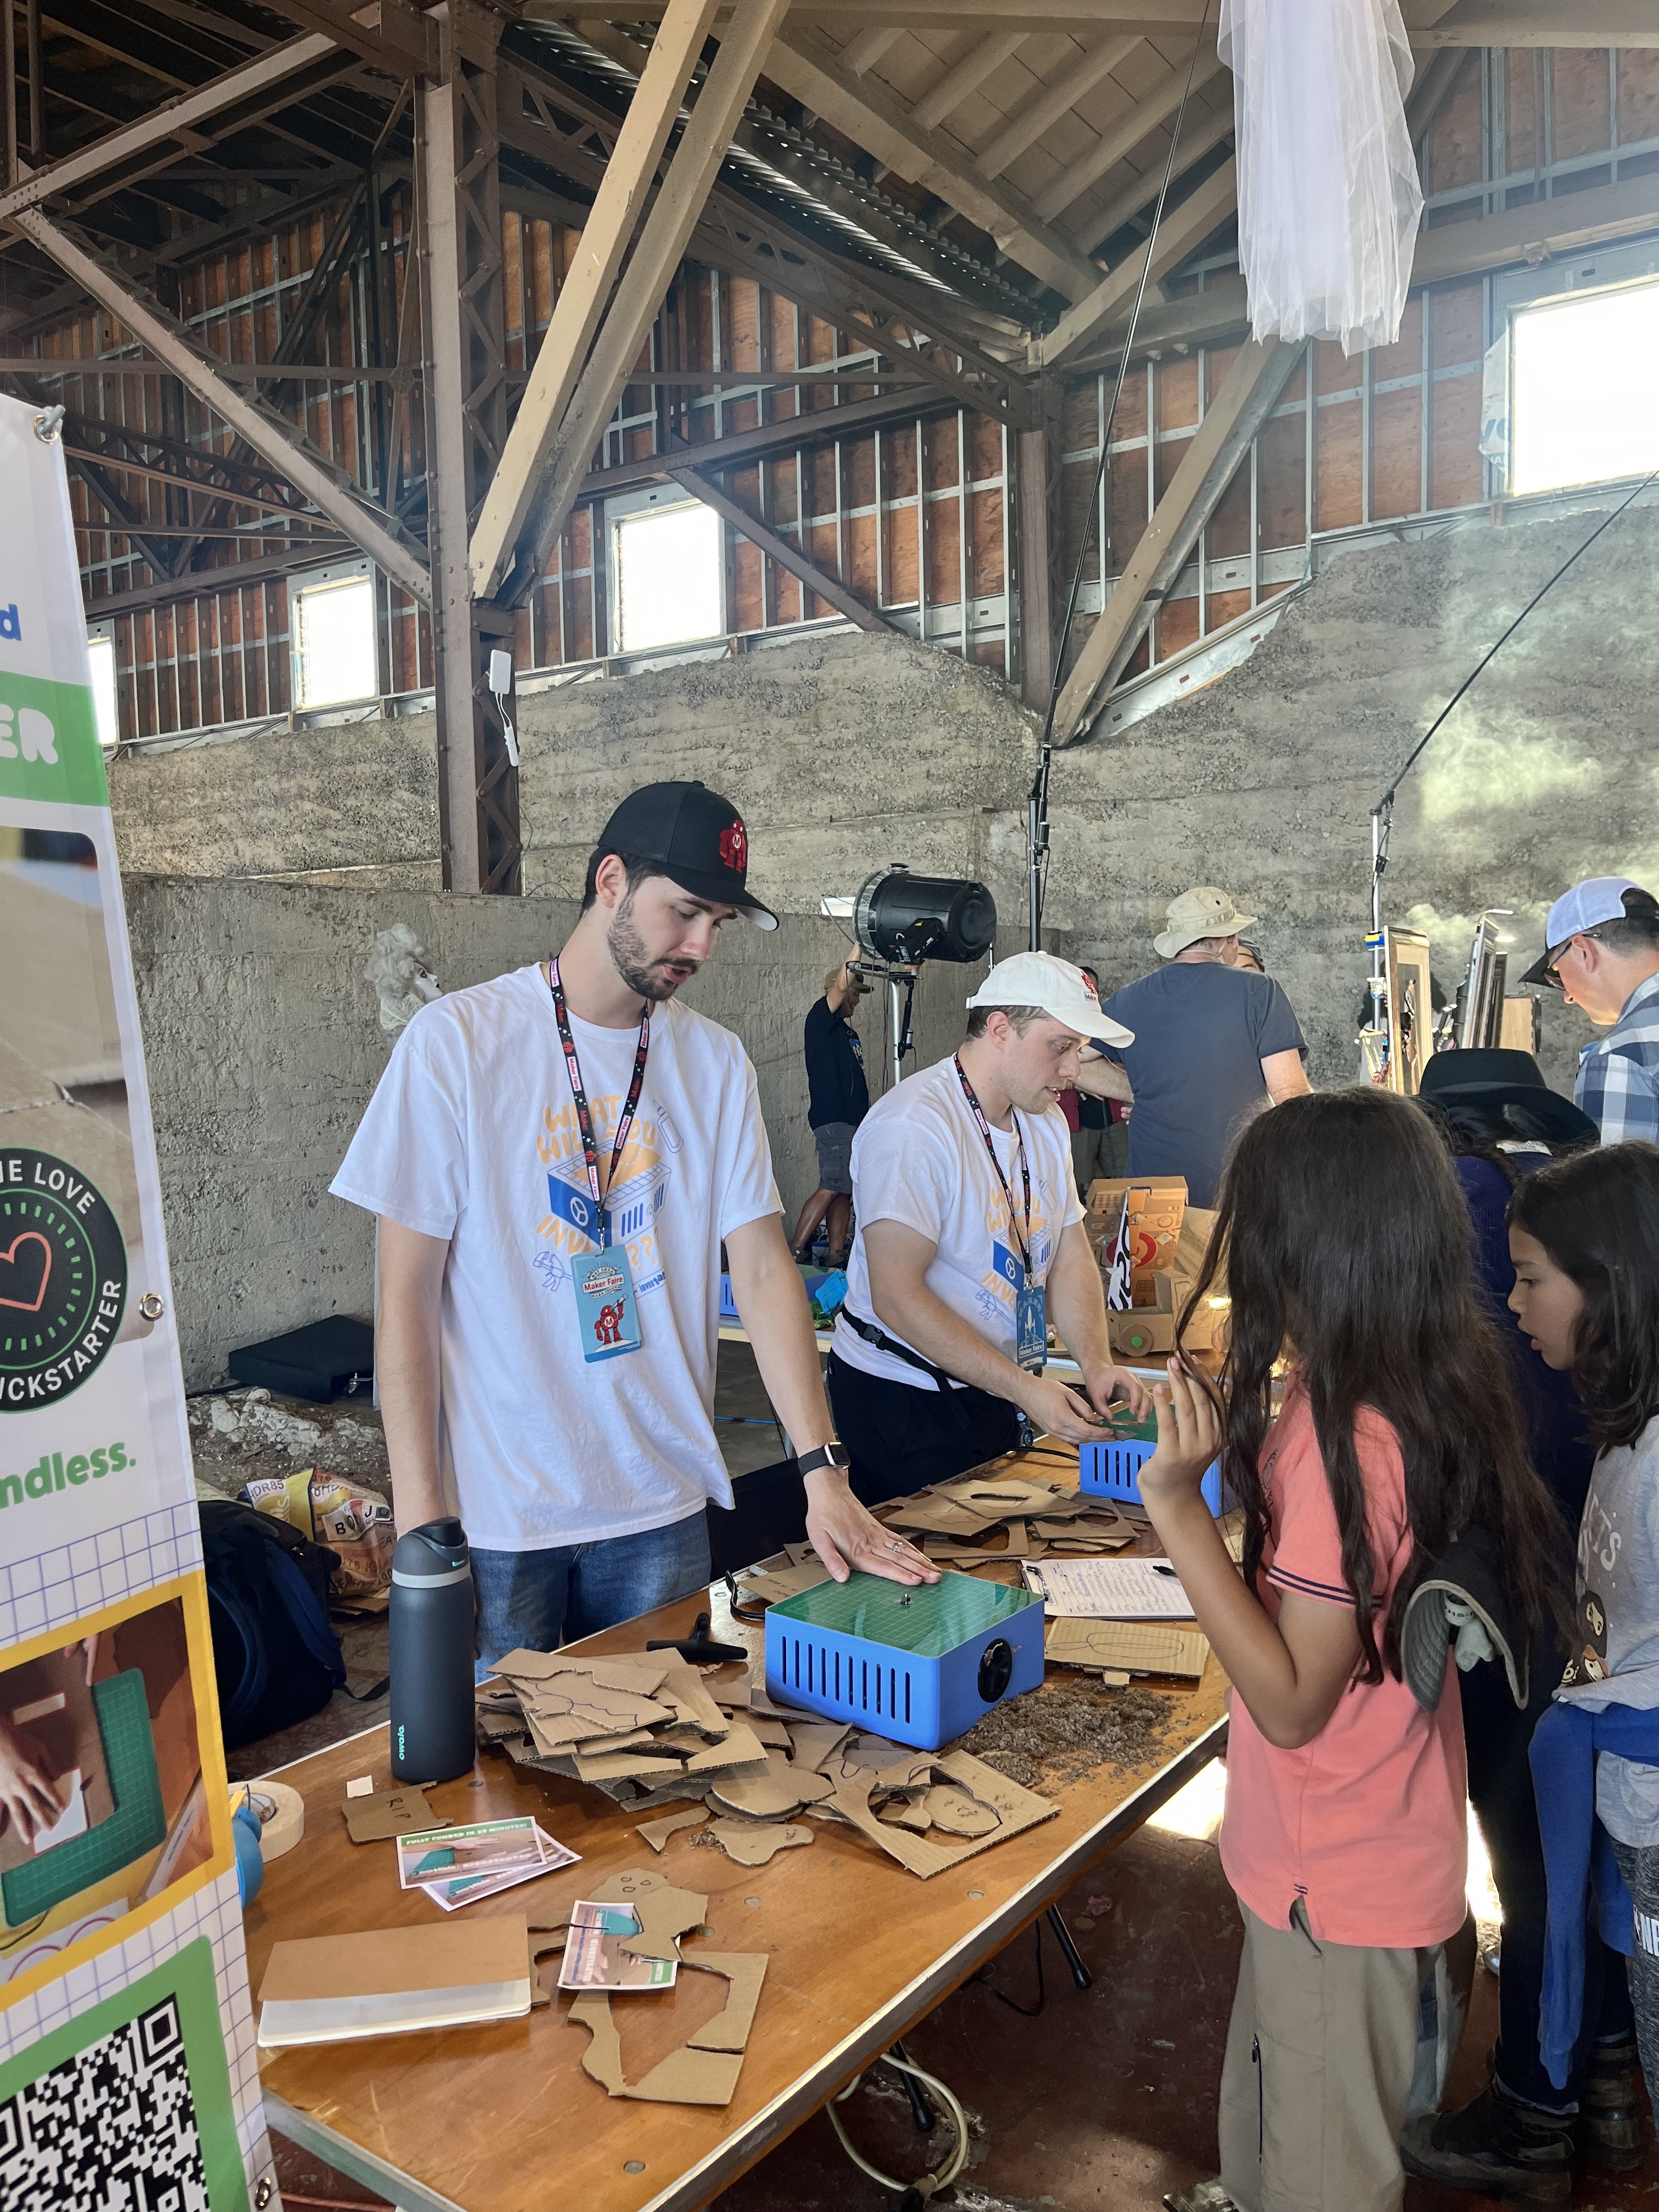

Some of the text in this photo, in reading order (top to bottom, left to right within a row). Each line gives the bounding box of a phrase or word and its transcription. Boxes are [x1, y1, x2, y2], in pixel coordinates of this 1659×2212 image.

[34, 1162, 96, 1215] LOVE
[584, 1277, 623, 1291] Maker Faire
[335, 1522, 346, 1534] B
